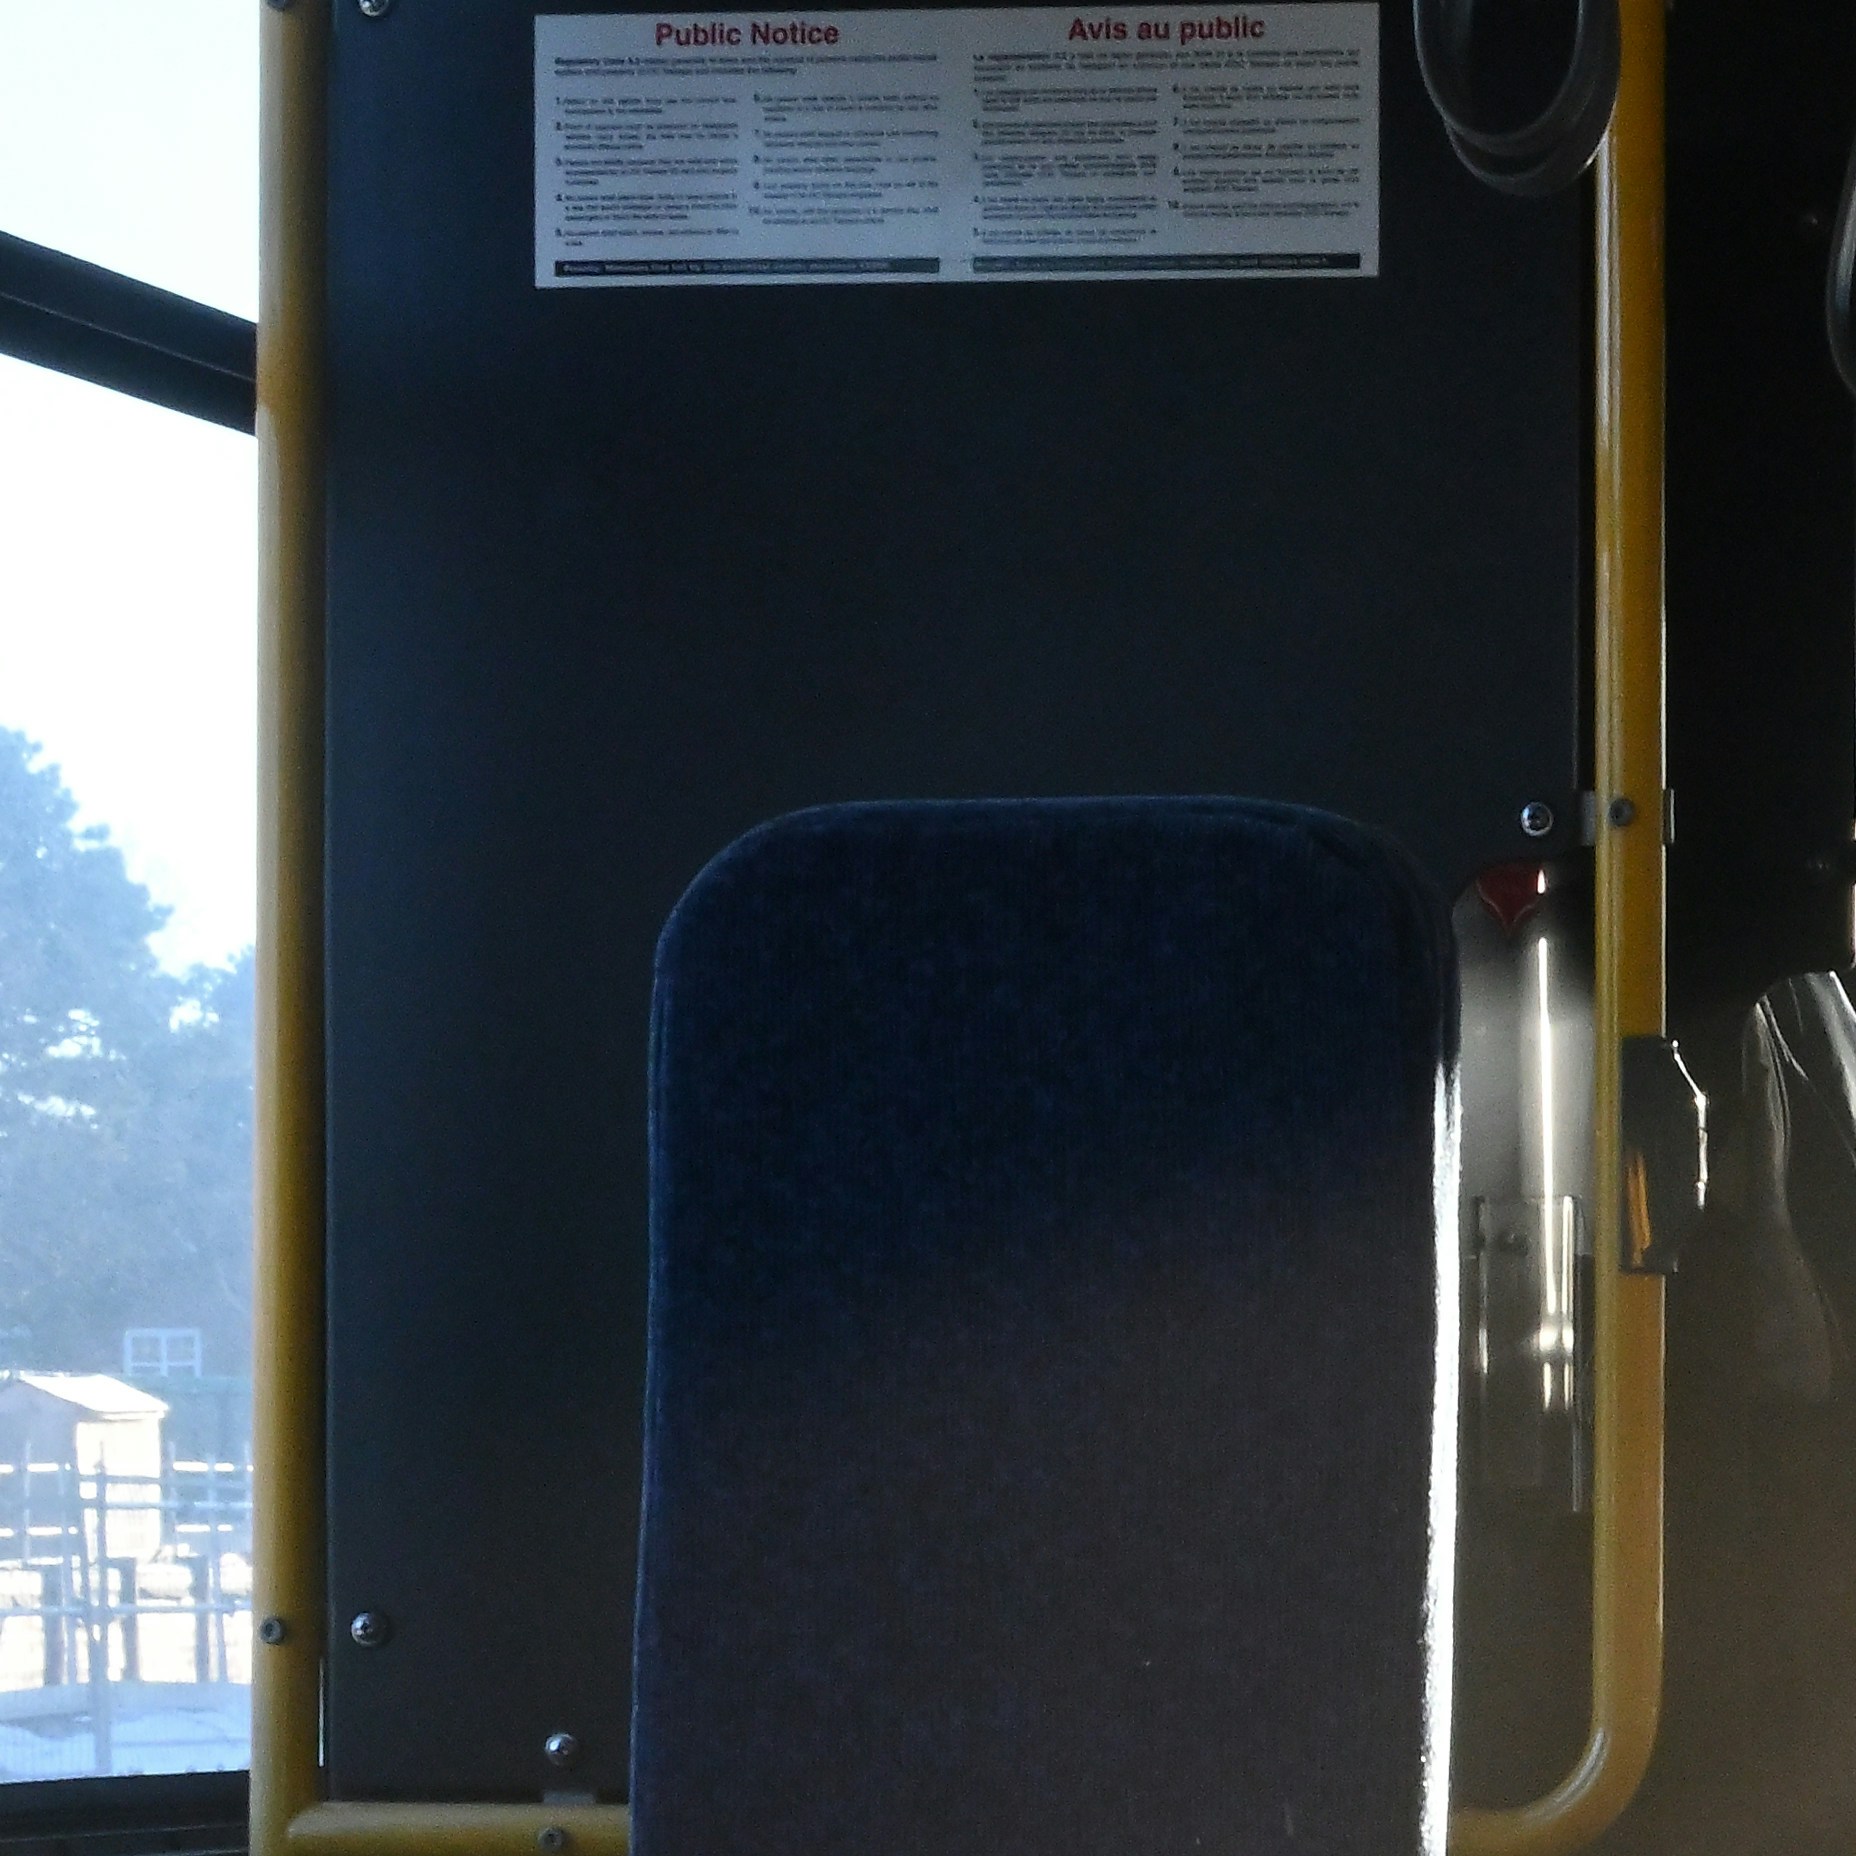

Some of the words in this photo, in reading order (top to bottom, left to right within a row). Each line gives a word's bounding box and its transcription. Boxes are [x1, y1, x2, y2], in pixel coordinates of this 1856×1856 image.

[655, 22, 742, 47] Public
[750, 20, 840, 46] Notice
[1068, 16, 1128, 41] Avis
[1136, 20, 1171, 41] au
[1179, 15, 1265, 46] public
